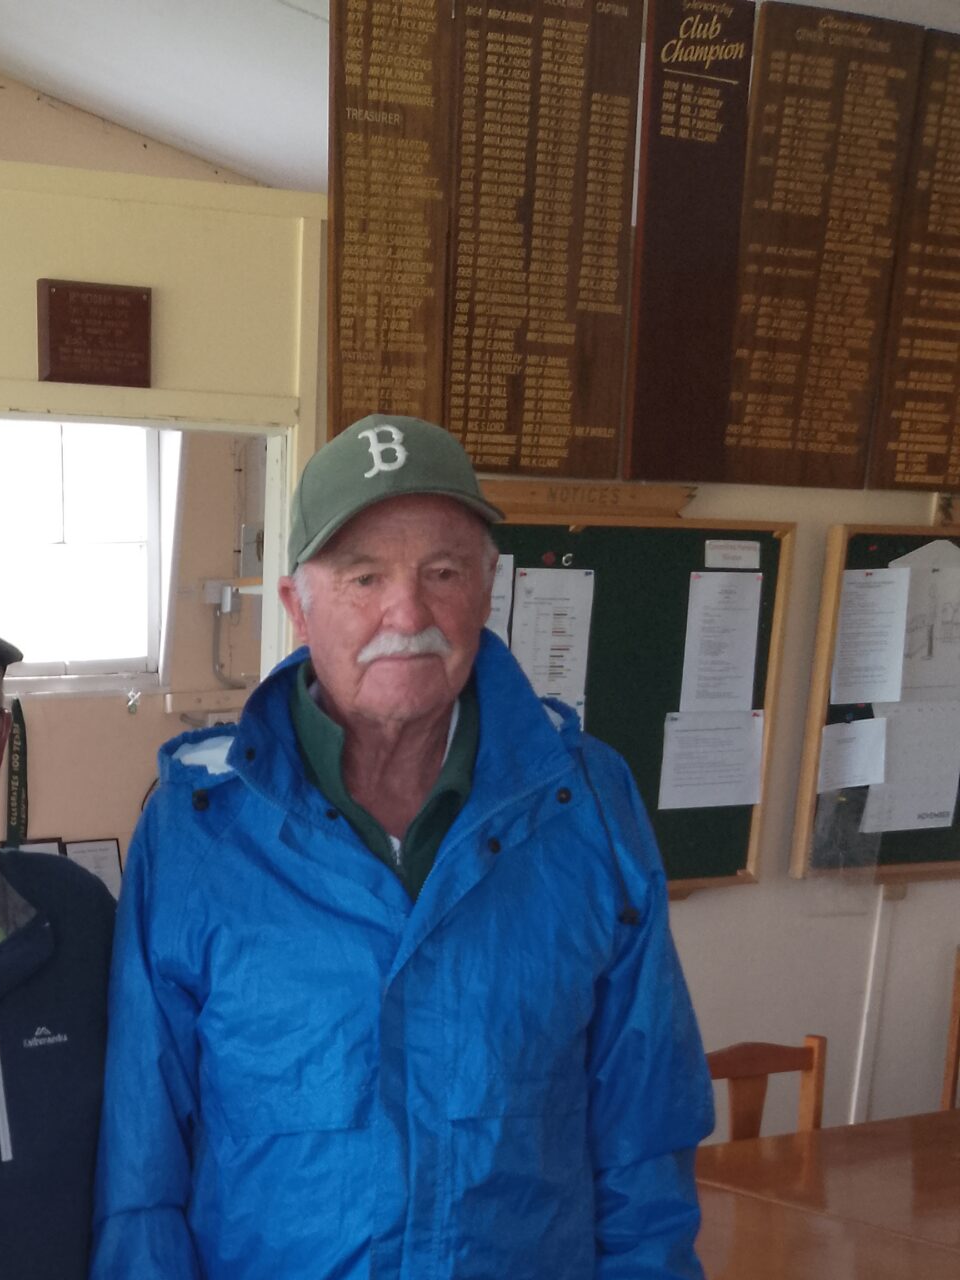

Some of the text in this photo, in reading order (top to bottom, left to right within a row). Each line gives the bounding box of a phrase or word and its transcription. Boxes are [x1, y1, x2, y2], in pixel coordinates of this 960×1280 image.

[596, 2, 628, 17] CAPTAIN
[679, 14, 722, 40] Club
[661, 38, 745, 70] Champion
[346, 107, 400, 125] TREASURER
[358, 424, 409, 478] B
[547, 487, 621, 504] NOTICES
[12, 754, 20, 771] 100
[10, 775, 19, 827] CELEBRATES
